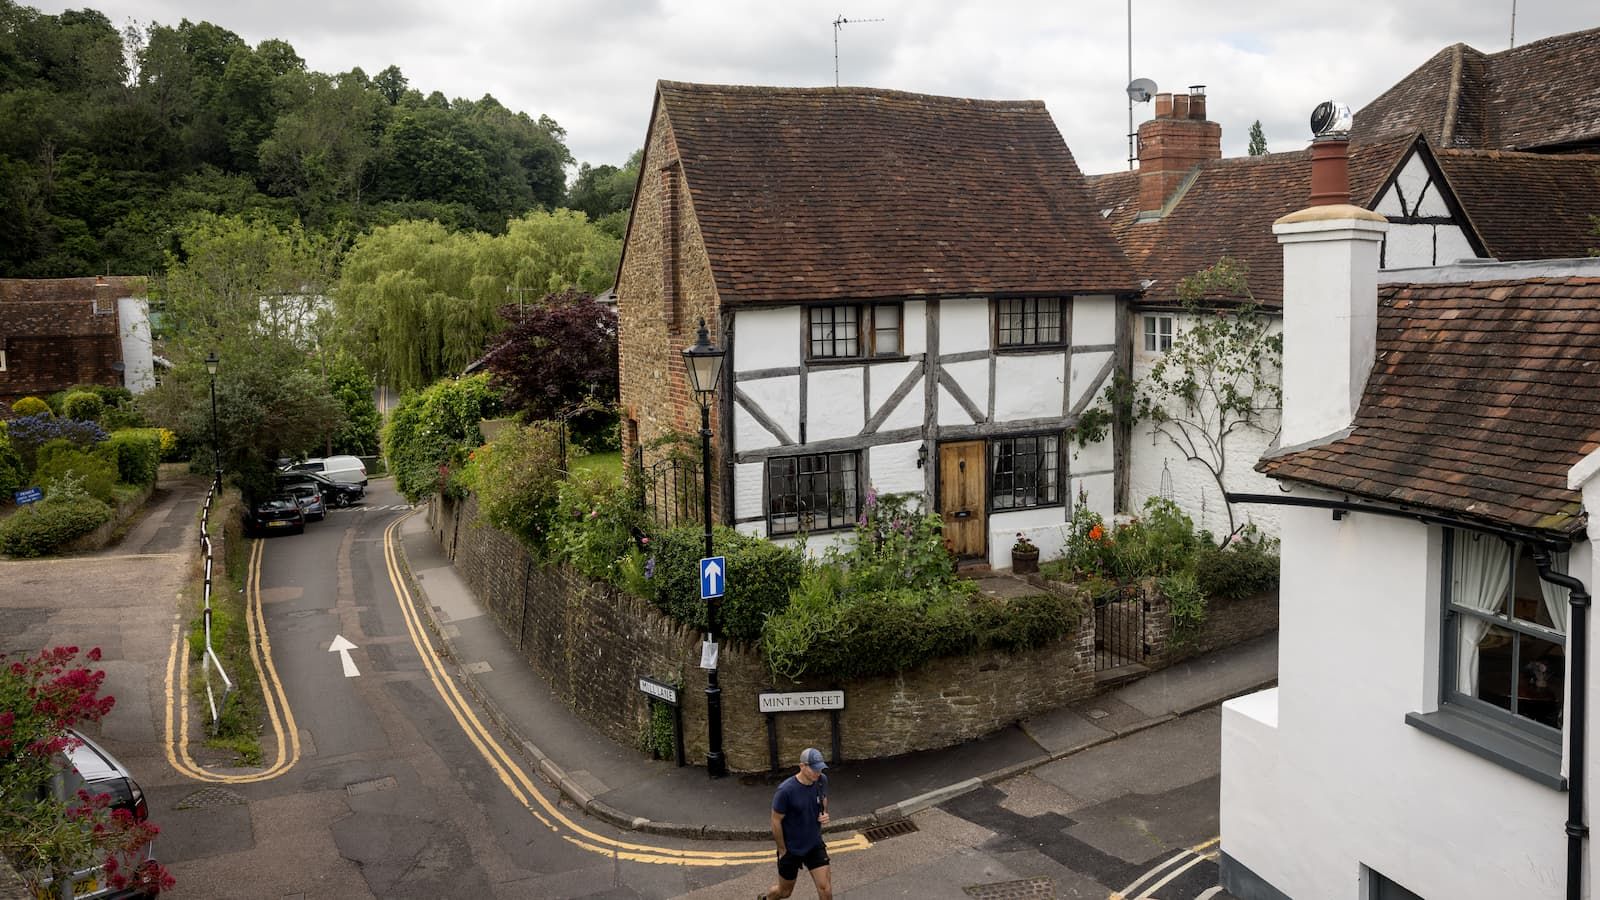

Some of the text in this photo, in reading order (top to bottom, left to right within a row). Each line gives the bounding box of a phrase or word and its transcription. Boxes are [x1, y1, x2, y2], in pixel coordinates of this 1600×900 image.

[642, 681, 673, 700] MILL LANE
[762, 695, 841, 707] MINT STREET
